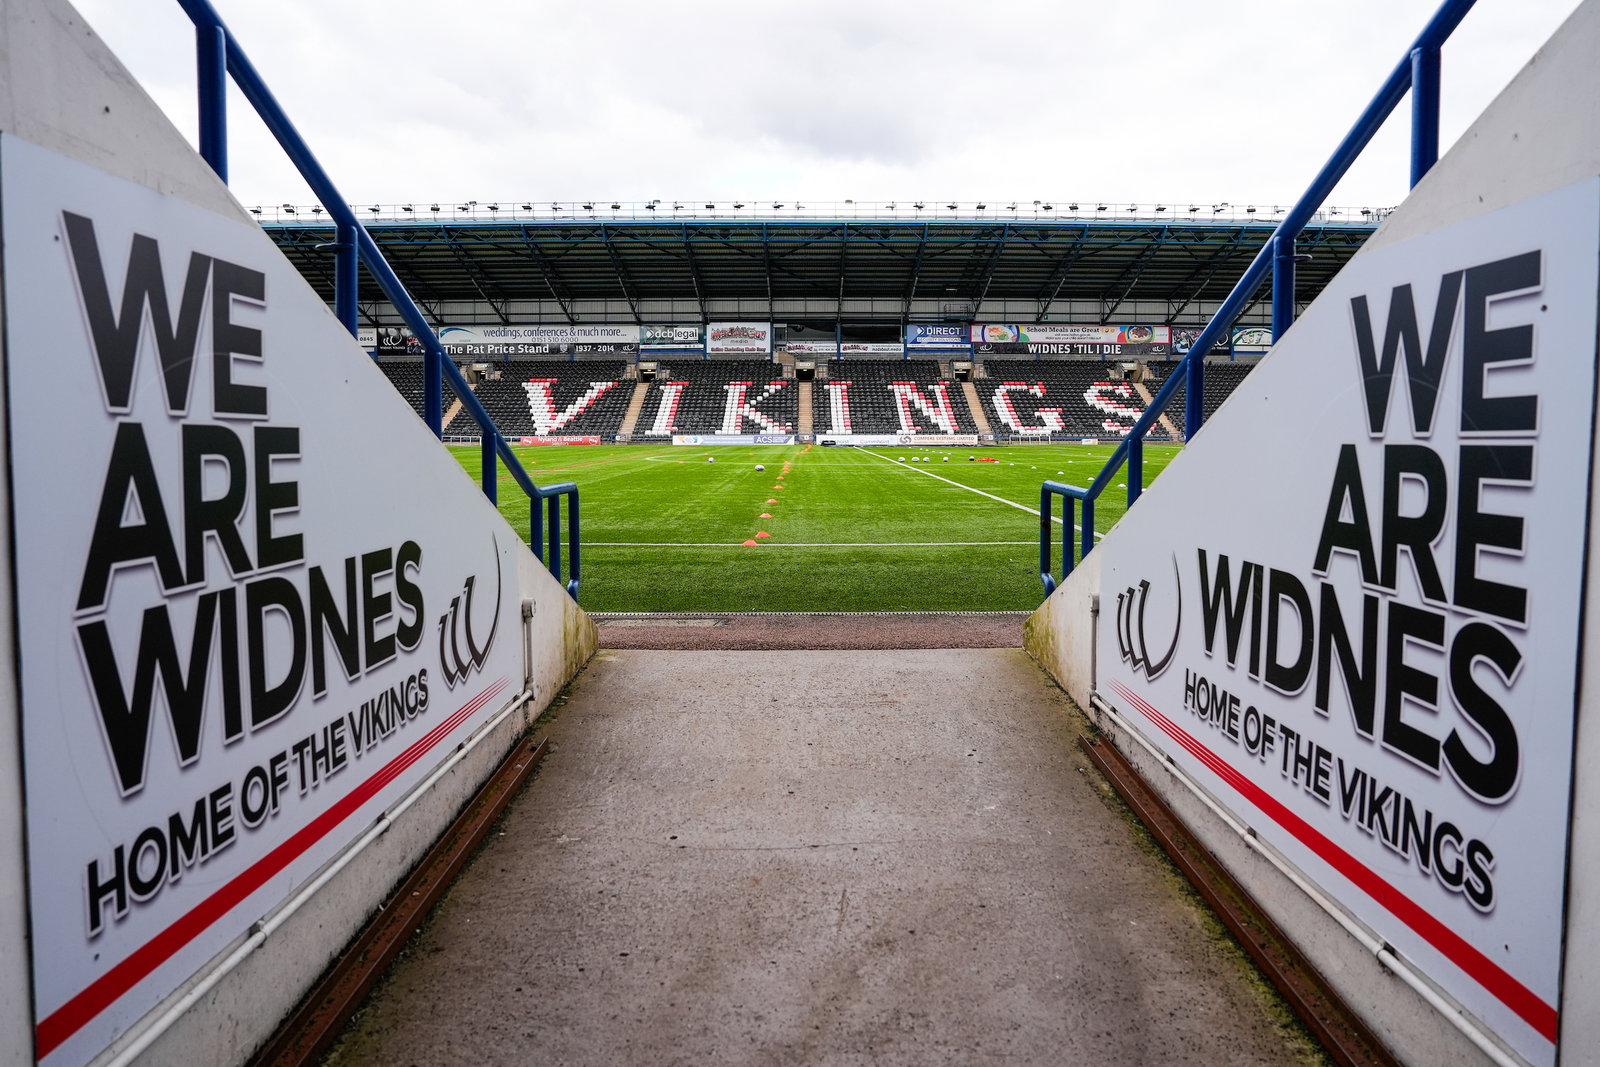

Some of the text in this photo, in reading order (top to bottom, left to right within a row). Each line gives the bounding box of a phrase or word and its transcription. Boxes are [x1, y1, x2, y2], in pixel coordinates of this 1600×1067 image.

[62, 209, 267, 415] WE
[443, 343, 549, 354] The Pat Price Stand
[483, 326, 627, 339] weddings, conferences & much more...
[926, 327, 962, 335] DIRECT
[1027, 344, 1071, 354] WIDNES
[1096, 344, 1100, 354] I
[1103, 344, 1122, 354] DIE
[1350, 249, 1542, 434] WE
[77, 422, 304, 613] ARE
[1312, 444, 1534, 625] ARE
[76, 540, 425, 792] WIDNES
[1198, 548, 1522, 801] WIDNES
[87, 668, 428, 932] HOME OF THE VIKINGS
[1185, 668, 1494, 909] HOME OF THE VIKINGS
